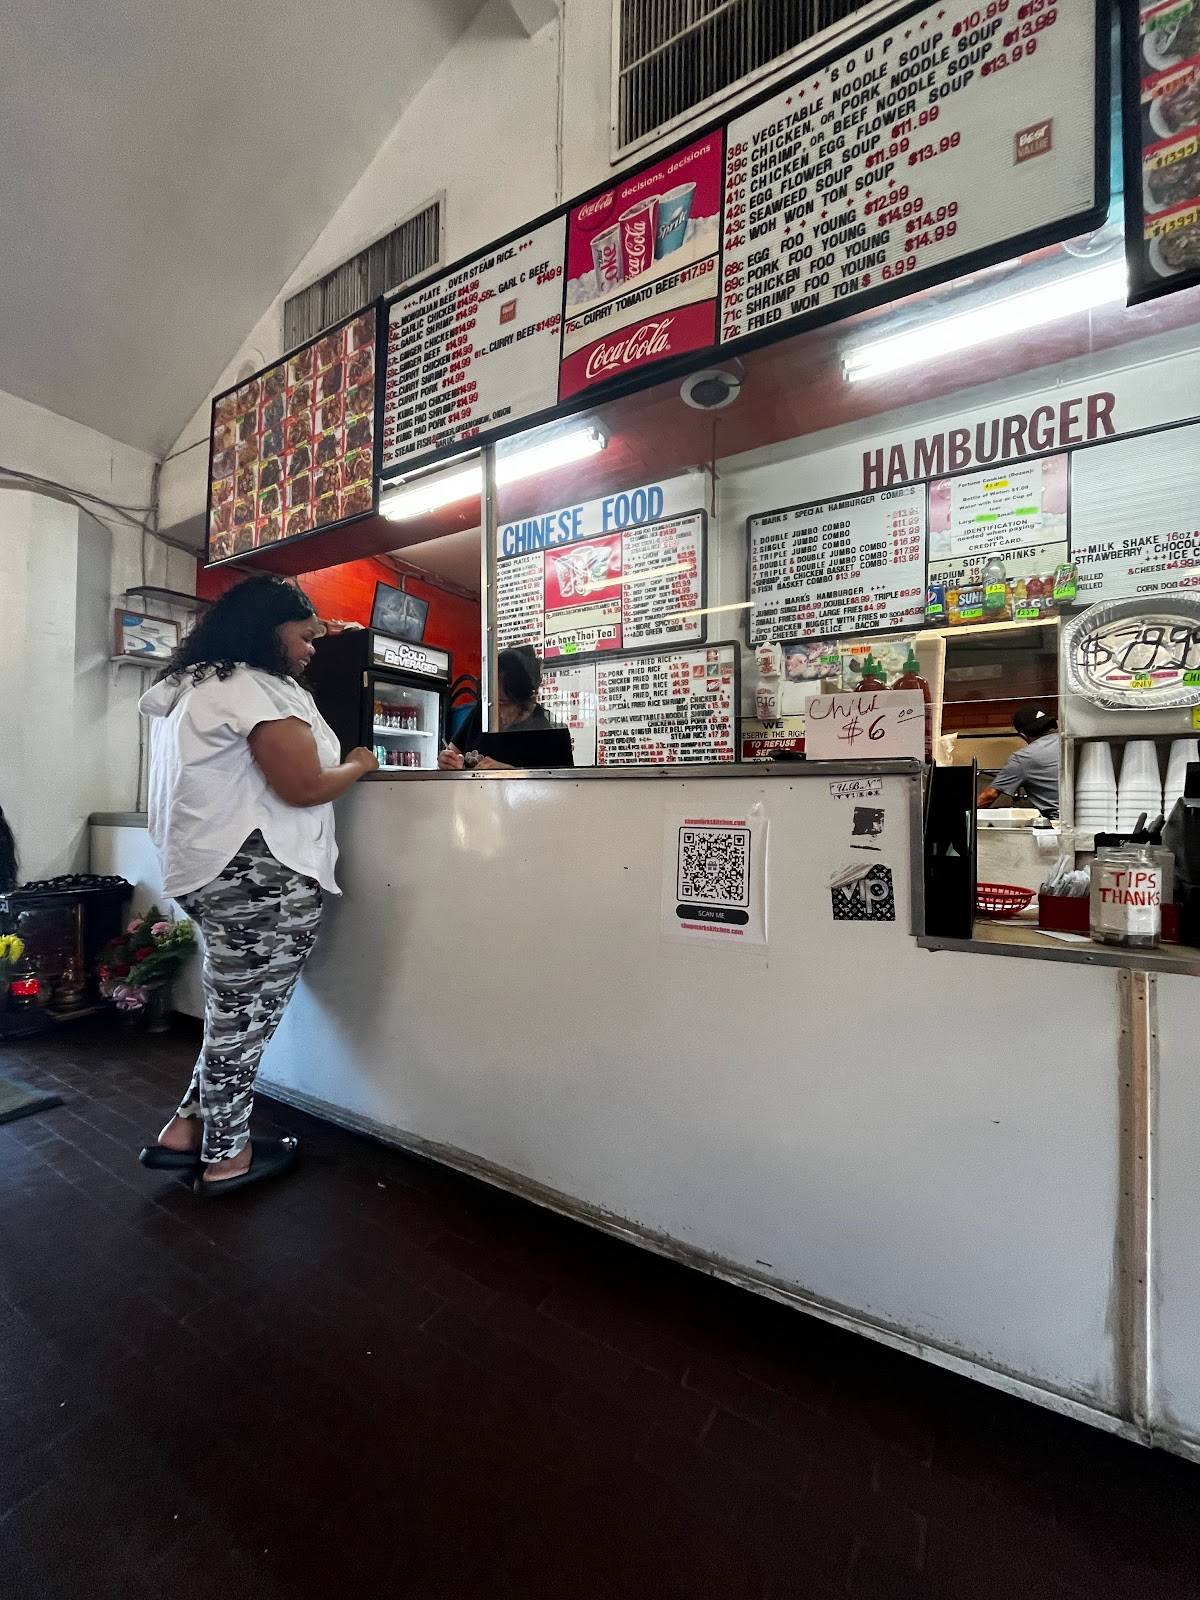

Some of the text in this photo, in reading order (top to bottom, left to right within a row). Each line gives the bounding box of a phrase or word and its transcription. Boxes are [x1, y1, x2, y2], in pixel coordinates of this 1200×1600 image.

[820, 111, 834, 125] OR
[841, 83, 880, 115] PORK
[891, 46, 950, 89] NOODLE
[958, 18, 1002, 52] SOUP
[752, 32, 942, 146] VEGETABLE NOODLE SOUP
[810, 132, 824, 146] OR
[833, 106, 868, 135] BEEF
[877, 71, 936, 113] NOODLE
[948, 42, 992, 76] SOUP
[750, 38, 1037, 193] CHICKEN EGG FLOWER SOUP $13.99
[750, 105, 939, 209] EGG FLOWER SOUP $11.99
[622, 144, 710, 198] decisions, decisions
[750, 138, 910, 224] SEAWEED SOUP $11.99
[750, 132, 960, 242] WOH WON TON SOUP $13.99
[748, 186, 909, 268] EGG FOO YOUNG $12.99
[748, 198, 923, 283] PORK FOO YOUNG $14.99
[746, 202, 958, 300] CHICKEN FOO YOUNG $14.99
[448, 258, 494, 288] OVER STEAM
[746, 220, 956, 315] SHRIMP FOO YOUNG $14.99
[428, 261, 550, 324] CHICKEN BEEF
[584, 260, 714, 326] CURRY TOMATO BEEF $17.99
[748, 277, 858, 331] FRIED WON TON
[426, 316, 454, 335] SHRIMP
[490, 334, 515, 352] CURRY
[863, 391, 1116, 490] HAMBURGER
[828, 496, 876, 512] HAMBURGER
[502, 507, 584, 556] CHINESE
[602, 486, 664, 531] FOOD
[964, 519, 1028, 535] IDENTIFICATION
[760, 520, 850, 546] DOUBLE JUMBO COMBO
[760, 530, 850, 553] SINGLE JUMBO COMBO
[958, 524, 1034, 542] needed paying
[760, 539, 850, 562] TRIPLE JUMBO COMBO
[969, 542, 997, 551] CREDIT
[1074, 539, 1200, 565] STRAWBERRY CHOCOL
[1088, 542, 1114, 554] MILK
[1123, 535, 1160, 548] SHAKE
[760, 541, 886, 570] DOUBLE DOUBLE JUMBO COMBO
[962, 557, 986, 568] SOFT
[1169, 550, 1188, 560] ICE
[760, 551, 888, 580] TRIPLE DOUBLE JUMBO COMBO
[793, 559, 888, 580] CHICKEN BASKET COMBO
[1135, 564, 1166, 574] CHEESE
[758, 576, 832, 594] FISH BASKET COMBO
[930, 570, 964, 582] MEDIUM
[816, 587, 864, 600] HAMBURGER
[874, 591, 899, 601] TRIPLE
[1137, 581, 1178, 592] CORN DOG
[756, 606, 863, 626] SMALL LARGE FRIES
[772, 613, 878, 632] CHICKEN NUGGET WITH FRIES
[546, 636, 556, 647] We
[558, 632, 576, 646] have
[576, 627, 594, 641] Thai
[597, 624, 616, 638] Tea!
[820, 620, 880, 634] SLICE BACON
[384, 649, 438, 674] BEVERAGES
[398, 644, 426, 663] COLD
[637, 658, 656, 666] FRIED
[608, 666, 645, 677] PORK FRIED
[608, 672, 668, 684] CHICKEN FRIED RICE
[608, 680, 668, 694] SHRIMP RICE
[654, 689, 668, 697] RICE
[742, 730, 806, 740] ESERVE THE RIGH
[762, 721, 784, 730] WE
[751, 739, 796, 748] TO REFUSE
[1110, 872, 1156, 888] TIPS
[1098, 888, 1160, 906] THANKS
[698, 910, 714, 918] SCAN
